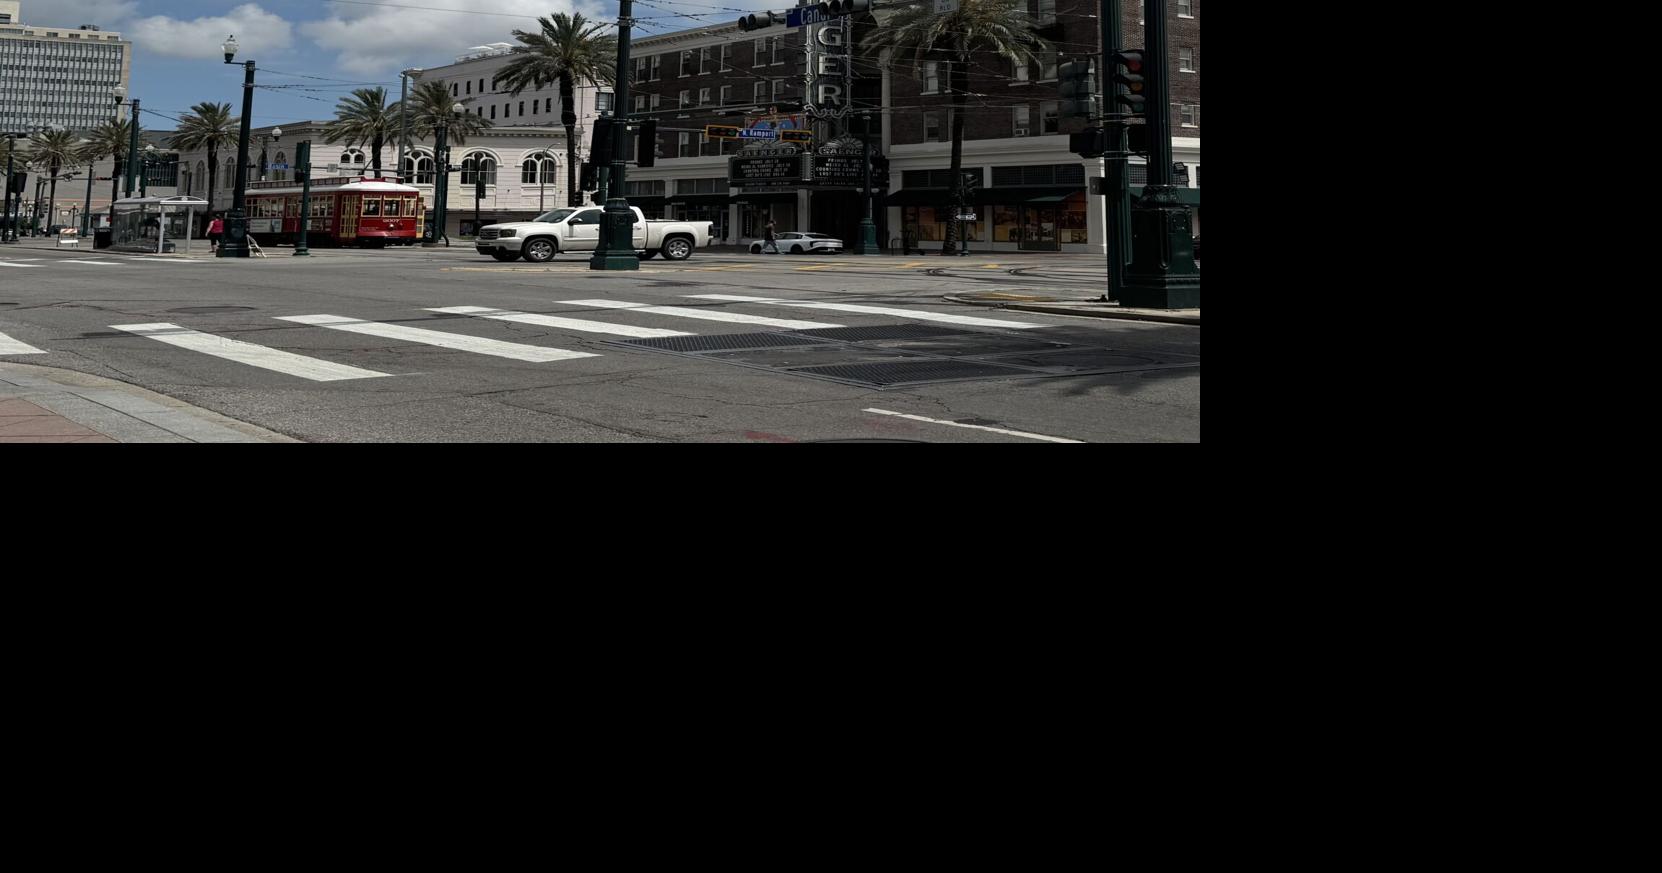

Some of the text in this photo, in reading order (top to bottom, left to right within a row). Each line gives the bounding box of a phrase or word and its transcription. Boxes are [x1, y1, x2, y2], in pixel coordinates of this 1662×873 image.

[800, 7, 830, 25] Can
[750, 129, 774, 138] Rampart
[737, 148, 792, 156] SAENGER
